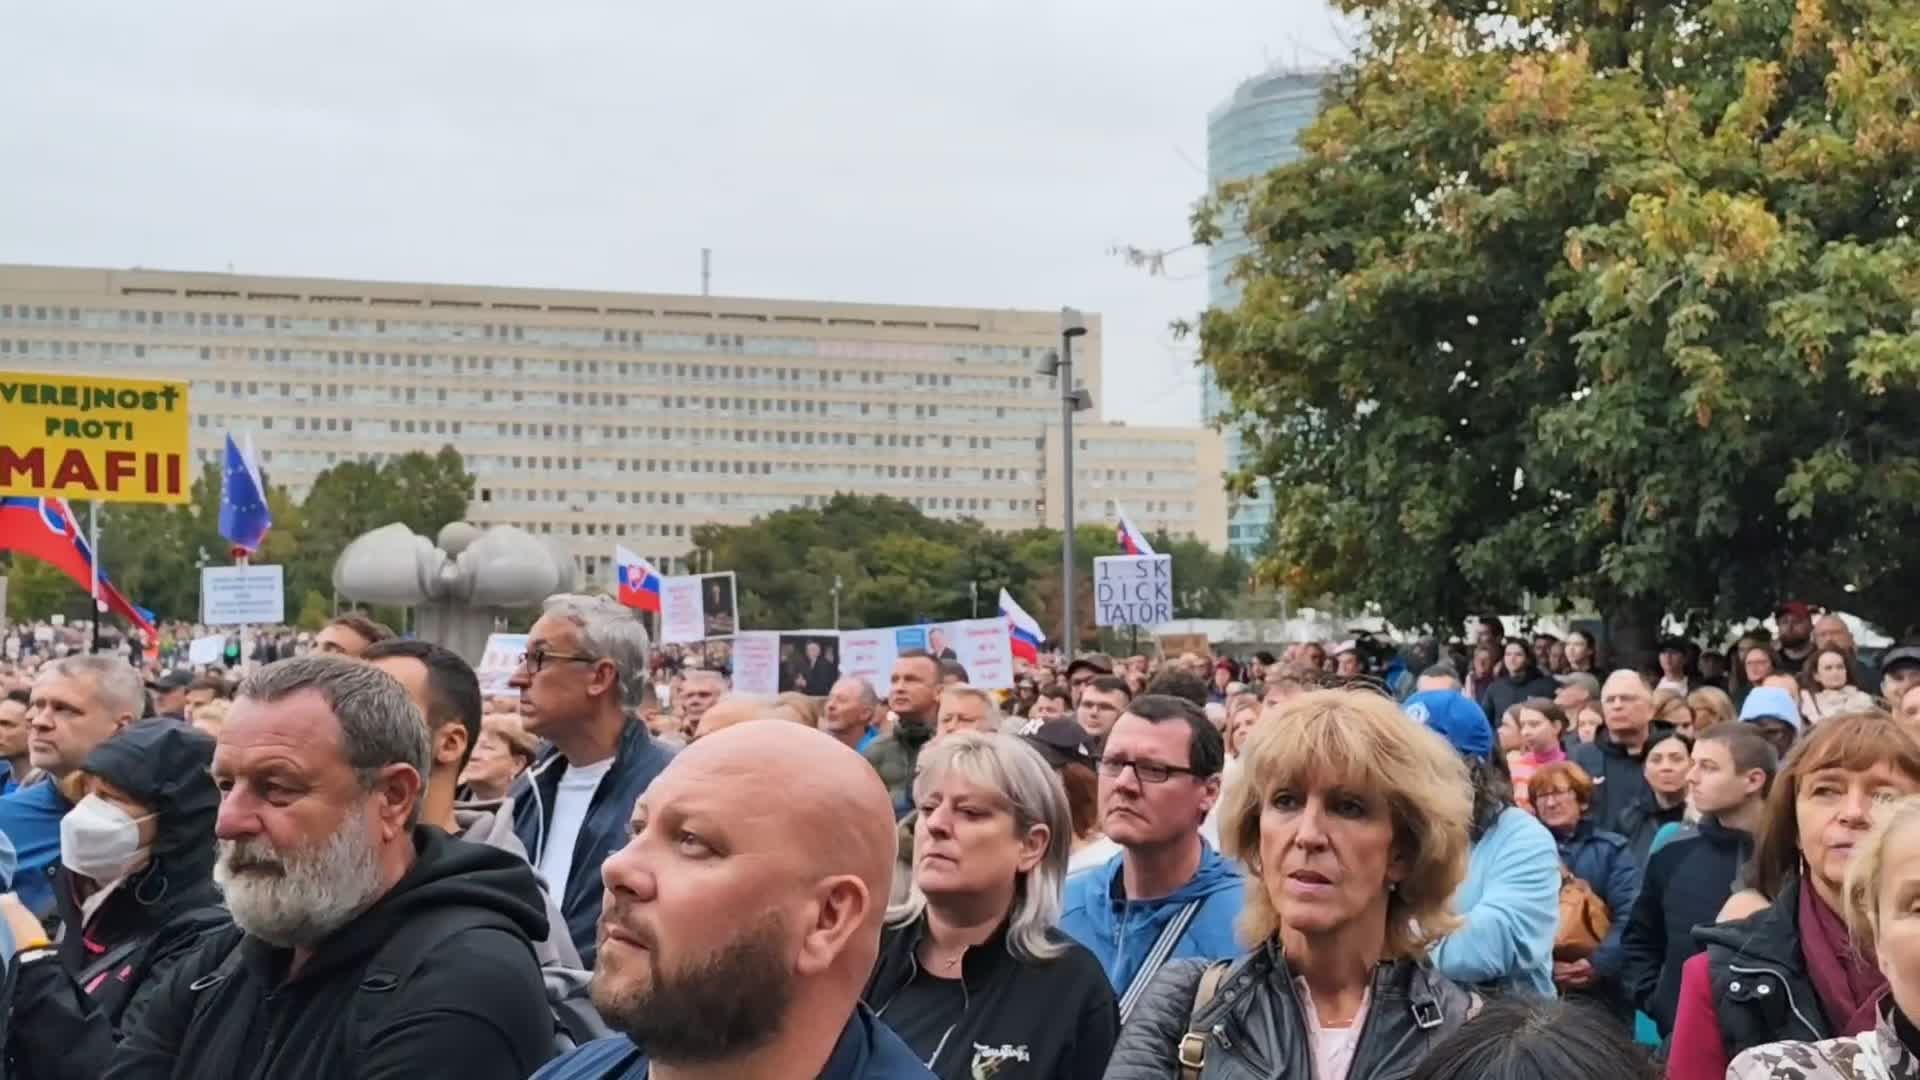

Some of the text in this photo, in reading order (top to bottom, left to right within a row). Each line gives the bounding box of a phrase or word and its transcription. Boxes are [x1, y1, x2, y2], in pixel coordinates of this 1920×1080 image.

[45, 417, 134, 441] PROTI
[0, 446, 181, 494] MAFII
[1135, 559, 1168, 578] SK
[1098, 582, 1168, 602] DICK
